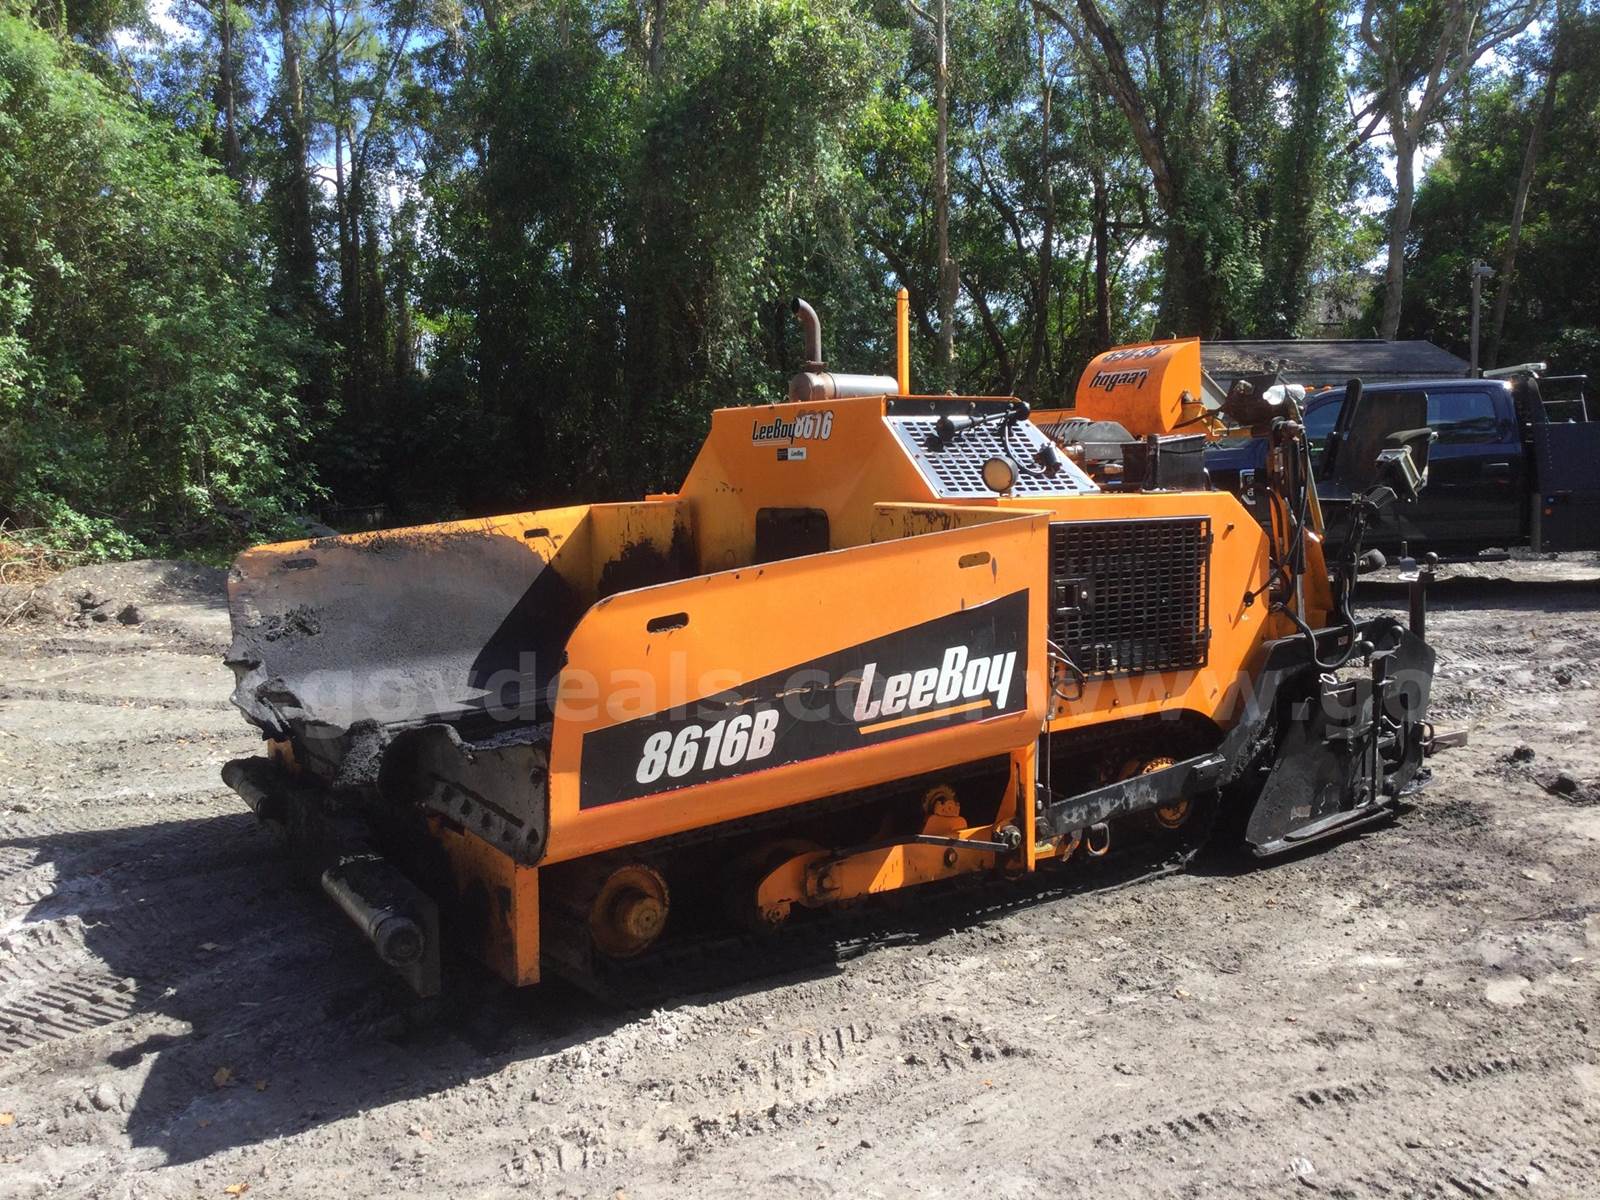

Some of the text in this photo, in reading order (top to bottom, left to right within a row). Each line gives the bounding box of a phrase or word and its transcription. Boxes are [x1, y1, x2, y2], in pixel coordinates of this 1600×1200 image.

[752, 410, 834, 445] LeeBoy 8616
[853, 645, 1017, 723] LeeBoy
[636, 709, 779, 784] 8616B
